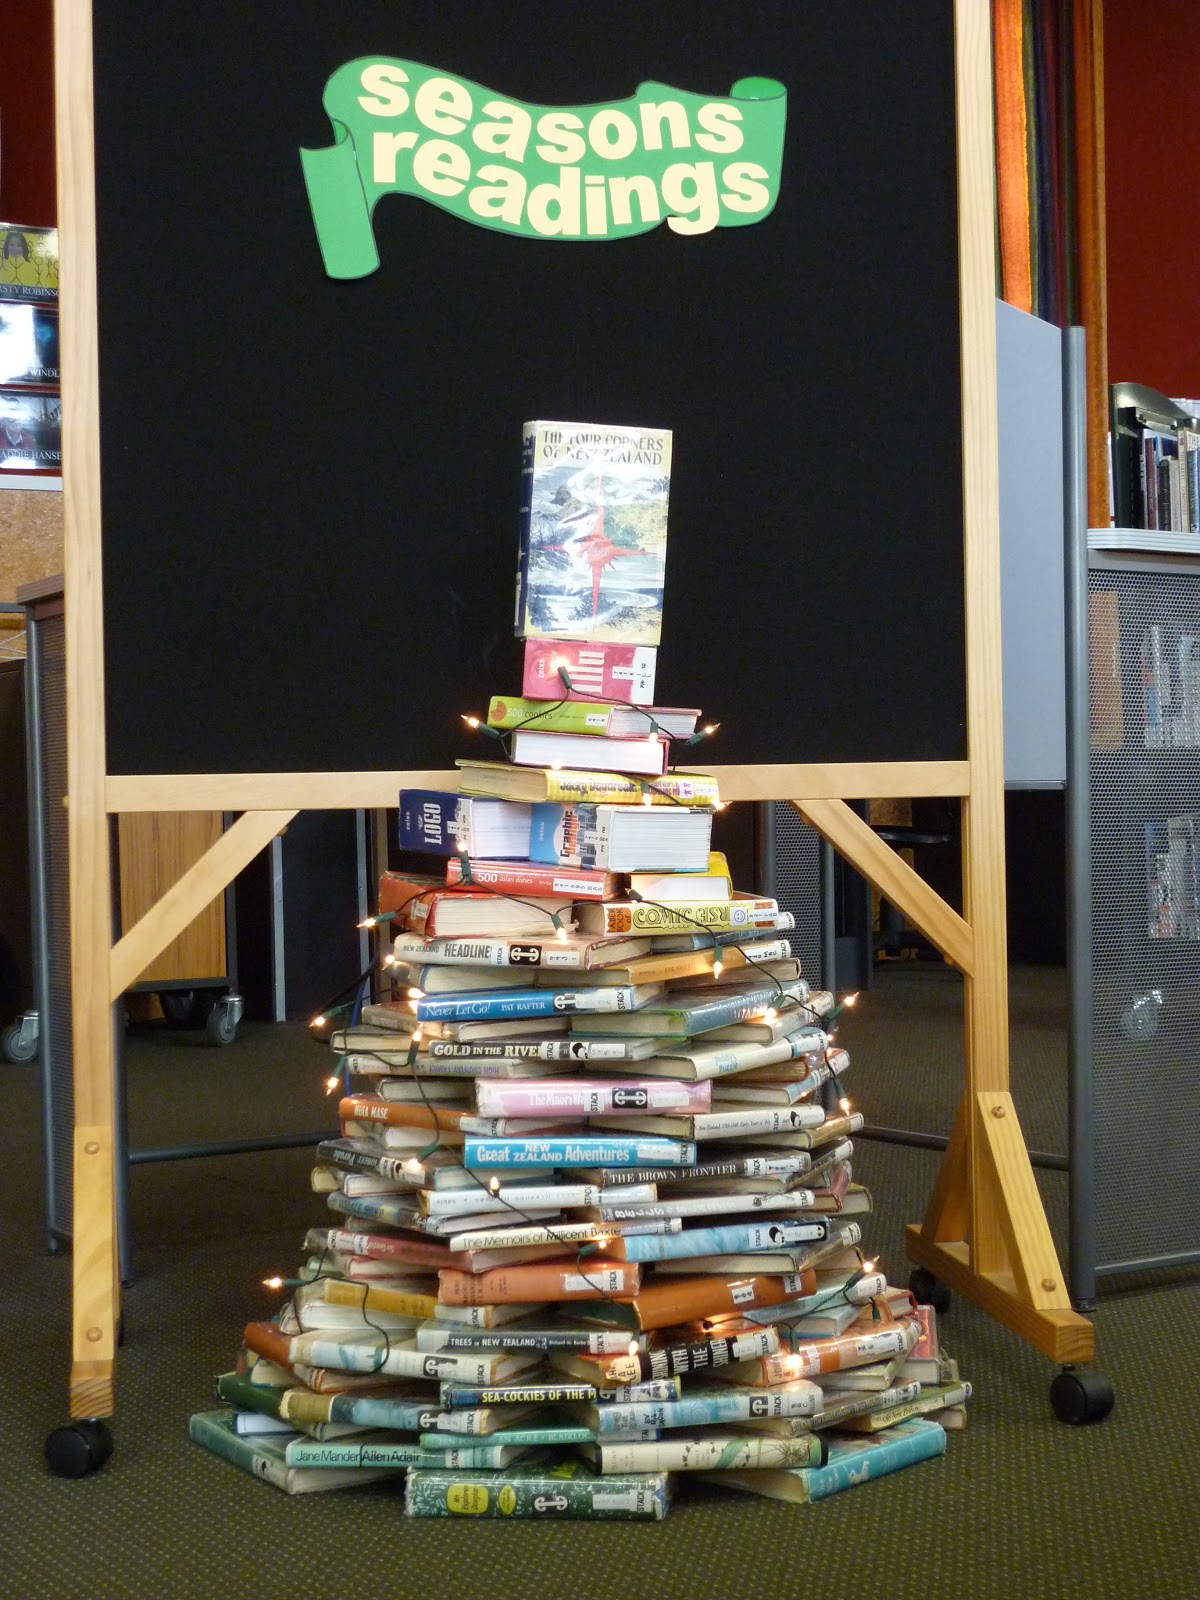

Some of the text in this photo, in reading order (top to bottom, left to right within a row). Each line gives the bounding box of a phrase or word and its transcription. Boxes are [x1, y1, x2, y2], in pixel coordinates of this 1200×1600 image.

[357, 63, 744, 164] seasons
[372, 131, 770, 236] readings
[605, 435, 664, 450] CORNERS
[507, 707, 523, 718] 500
[423, 803, 442, 845] LOGO
[478, 872, 498, 883] 500
[500, 875, 515, 883] asian
[515, 876, 533, 885] dishes
[607, 908, 616, 933] FABER
[616, 908, 624, 933] BOOK
[633, 906, 692, 925] COMIC
[425, 1001, 491, 1017] Never Let Go!
[501, 1002, 545, 1012] PAT RAFTER
[617, 990, 626, 1010] STACK
[434, 1044, 471, 1057] GOLD
[473, 1045, 484, 1055] IN
[484, 1044, 502, 1055] THE
[528, 1092, 545, 1106] The
[546, 1091, 572, 1106] Maori
[590, 1092, 599, 1112] STACK
[477, 1145, 510, 1162] Great
[513, 1152, 563, 1162] ZEALAND
[524, 1143, 550, 1153] NEW
[564, 1145, 630, 1162] Adventures
[680, 1143, 688, 1164] STACK
[609, 1164, 737, 1184] THE BROWN FRONTIER
[463, 1227, 622, 1248] The Memoirs of Millicent Baxte
[450, 1338, 472, 1347] TREES
[482, 1338, 500, 1347] NEW
[502, 1338, 535, 1347] ZEALAND
[760, 1334, 769, 1355] STACK
[671, 1348, 689, 1375] WITH
[693, 1346, 709, 1369] THE
[477, 1363, 485, 1384] STACK
[482, 1390, 545, 1403] SEA-COCKIES
[548, 1390, 563, 1401] OF
[565, 1389, 586, 1401] THE
[773, 1395, 781, 1416] STACK
[467, 1412, 475, 1434] STACK
[644, 1413, 651, 1424] BY
[500, 1435, 513, 1443] AN
[515, 1434, 539, 1443] ACRE
[296, 1449, 420, 1463] Jane Mander Allen Adair
[461, 1485, 470, 1511] Explorer
[471, 1487, 480, 1510] Douglas
[637, 1490, 645, 1512] STACK
